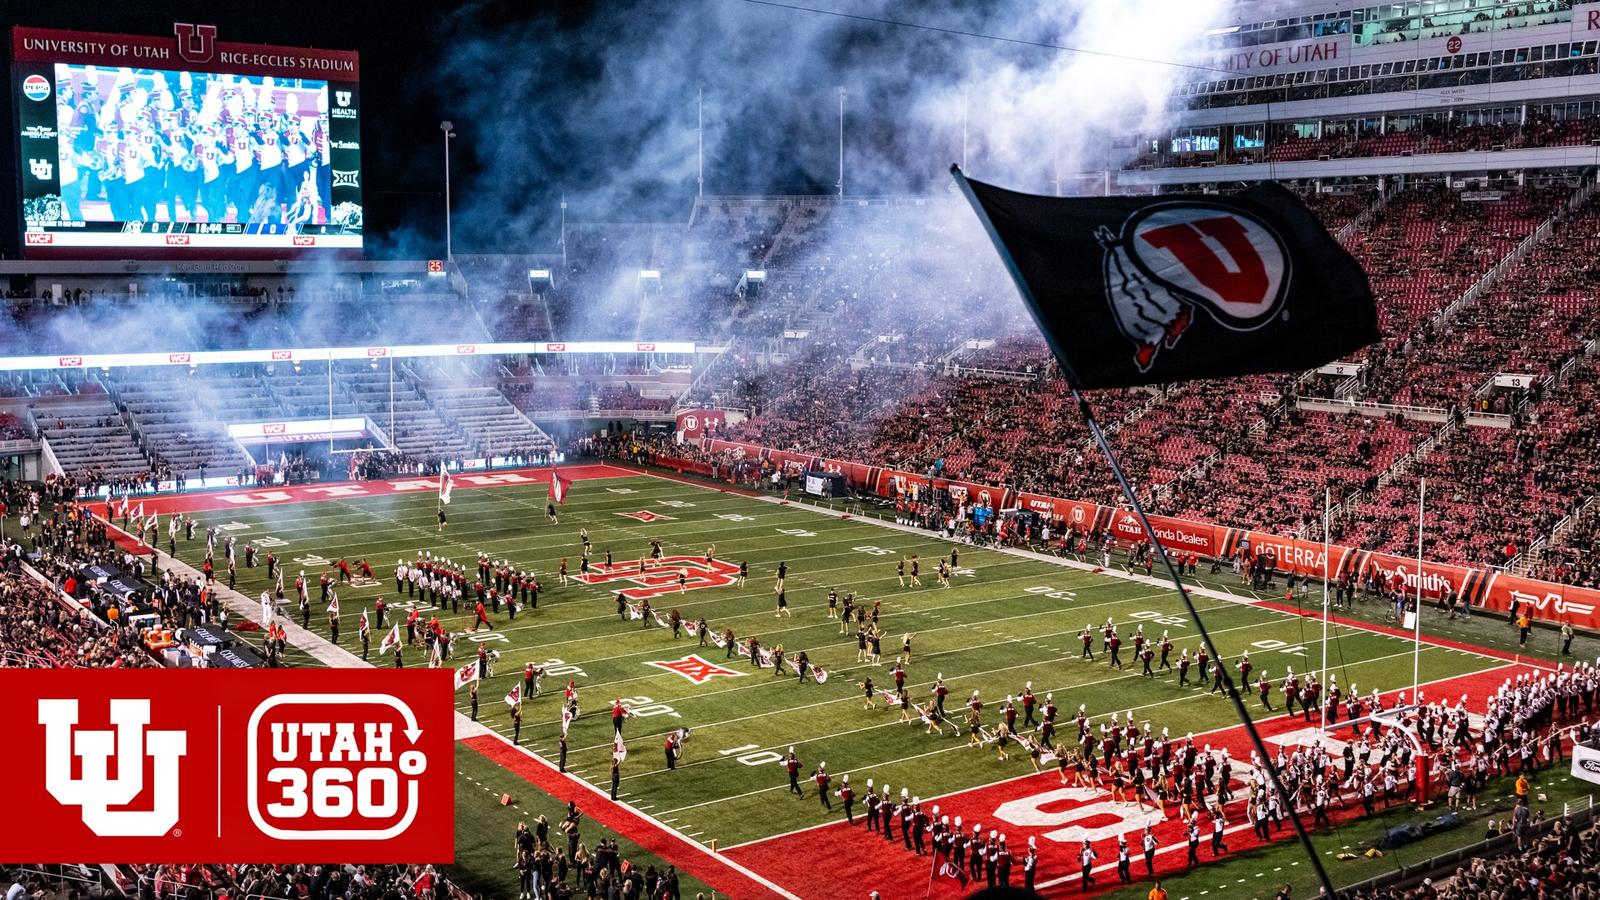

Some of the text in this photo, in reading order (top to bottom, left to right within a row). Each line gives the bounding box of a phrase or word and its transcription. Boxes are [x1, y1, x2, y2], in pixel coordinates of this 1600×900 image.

[174, 23, 217, 63] U
[1448, 40, 1461, 50] 22
[23, 38, 170, 59] UNIVERSITY OF UTAH
[1259, 49, 1282, 67] OF
[1288, 42, 1337, 64] UTAH
[220, 52, 354, 72] RICE-ECCLES STADIUM
[335, 91, 352, 107] U
[331, 108, 357, 116] HEALTH
[28, 234, 52, 243] WCF
[167, 235, 189, 244] WCF
[294, 237, 314, 245] WCF
[1139, 215, 1269, 304] U
[429, 261, 441, 271] 25
[458, 345, 475, 354] WCF
[547, 344, 565, 352] WCF
[637, 343, 655, 351] WCF
[272, 351, 291, 360] WCF
[368, 348, 385, 356] WCF
[60, 357, 82, 366] WCF
[170, 354, 190, 363] WCF
[1335, 366, 1344, 374] 12
[1511, 378, 1521, 387] 13
[263, 424, 285, 434] WCF
[283, 433, 322, 442] UTAH
[1117, 523, 1142, 535] UTAH
[1176, 530, 1208, 547] Dealers
[719, 744, 784, 766] 10
[1583, 759, 1600, 773] For
